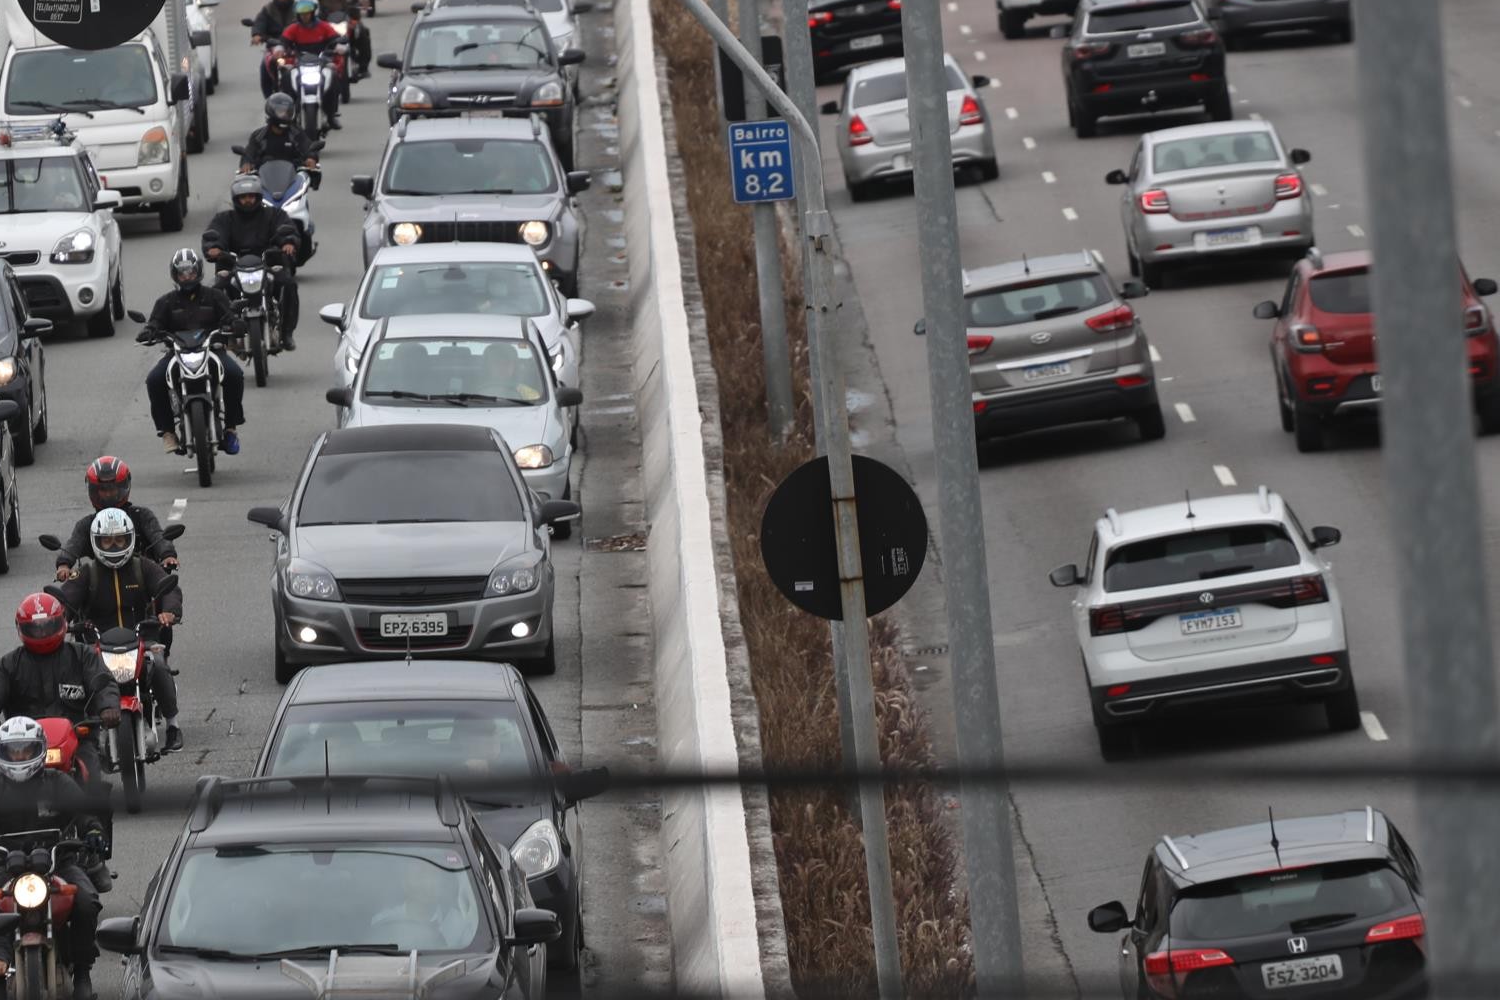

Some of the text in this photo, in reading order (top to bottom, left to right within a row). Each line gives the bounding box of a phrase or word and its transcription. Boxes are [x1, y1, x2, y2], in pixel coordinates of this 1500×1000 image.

[733, 127, 785, 141] Bairro
[740, 149, 783, 169] km
[744, 172, 785, 197] 8,2
